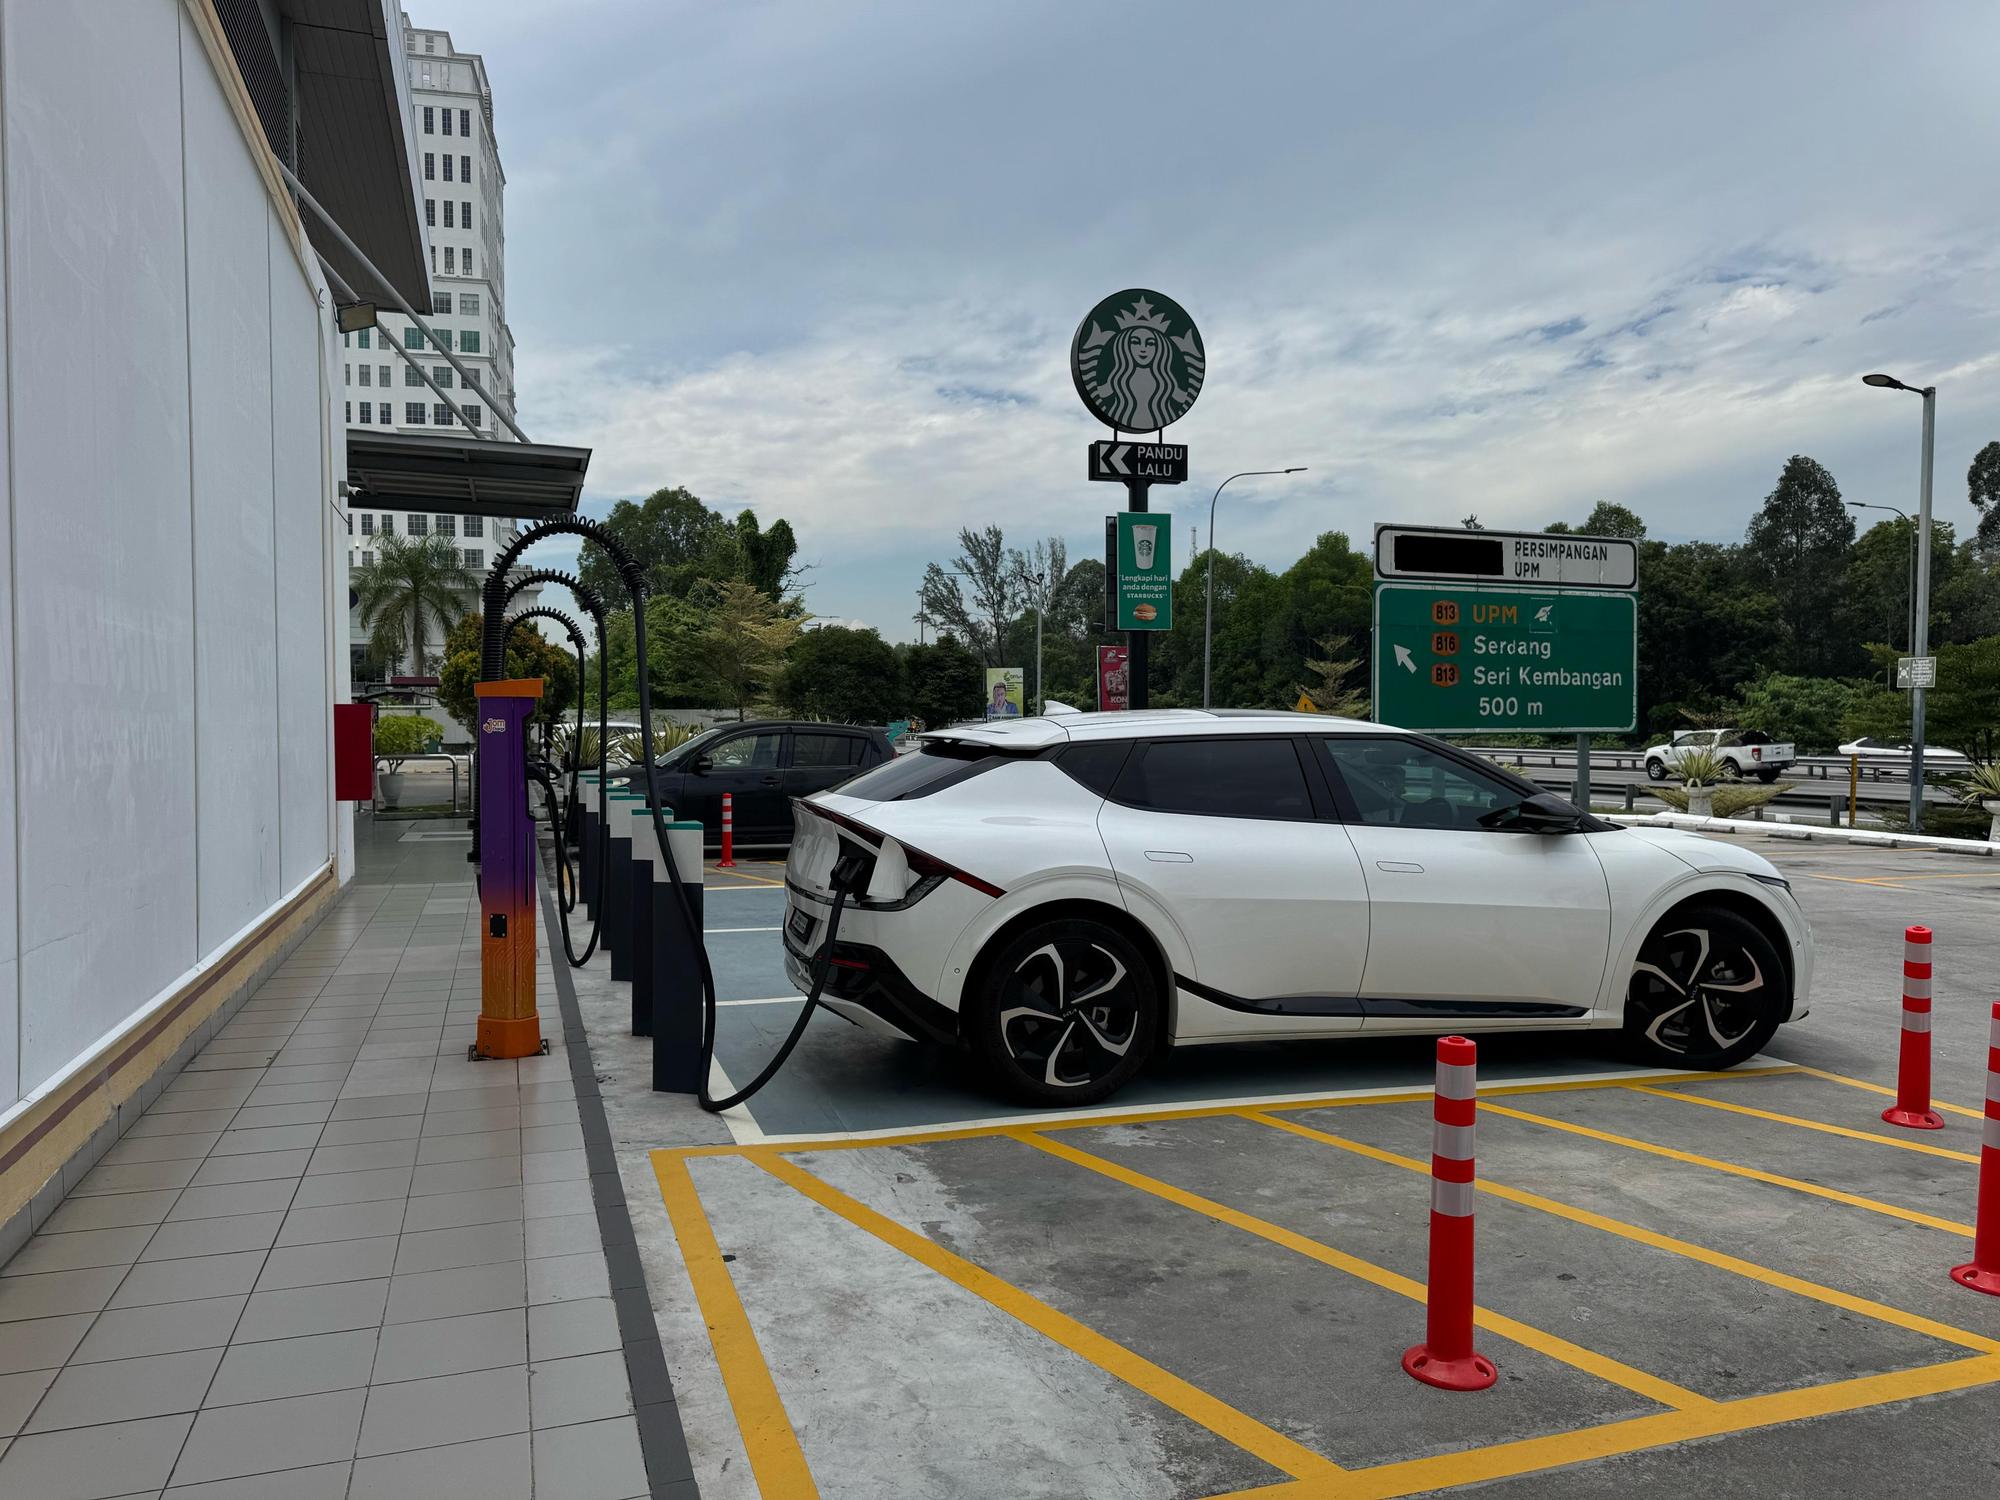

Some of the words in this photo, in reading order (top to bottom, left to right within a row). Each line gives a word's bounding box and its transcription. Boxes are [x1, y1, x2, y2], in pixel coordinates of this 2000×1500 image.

[1137, 445, 1183, 460] PANDU
[1137, 462, 1172, 476] LALU
[1514, 541, 1608, 561] PERSIMPANGAN
[1514, 562, 1540, 578] UPM
[1140, 583, 1167, 591] dengan
[1435, 604, 1456, 620] B13
[1472, 604, 1517, 624] UPM
[1435, 635, 1456, 651] B16
[1473, 635, 1551, 659] Serdang
[1435, 666, 1456, 682] B13
[1472, 666, 1511, 685] Seri
[1519, 667, 1622, 689] Kembangan
[1479, 697, 1518, 716] 500
[1527, 701, 1543, 716] m
